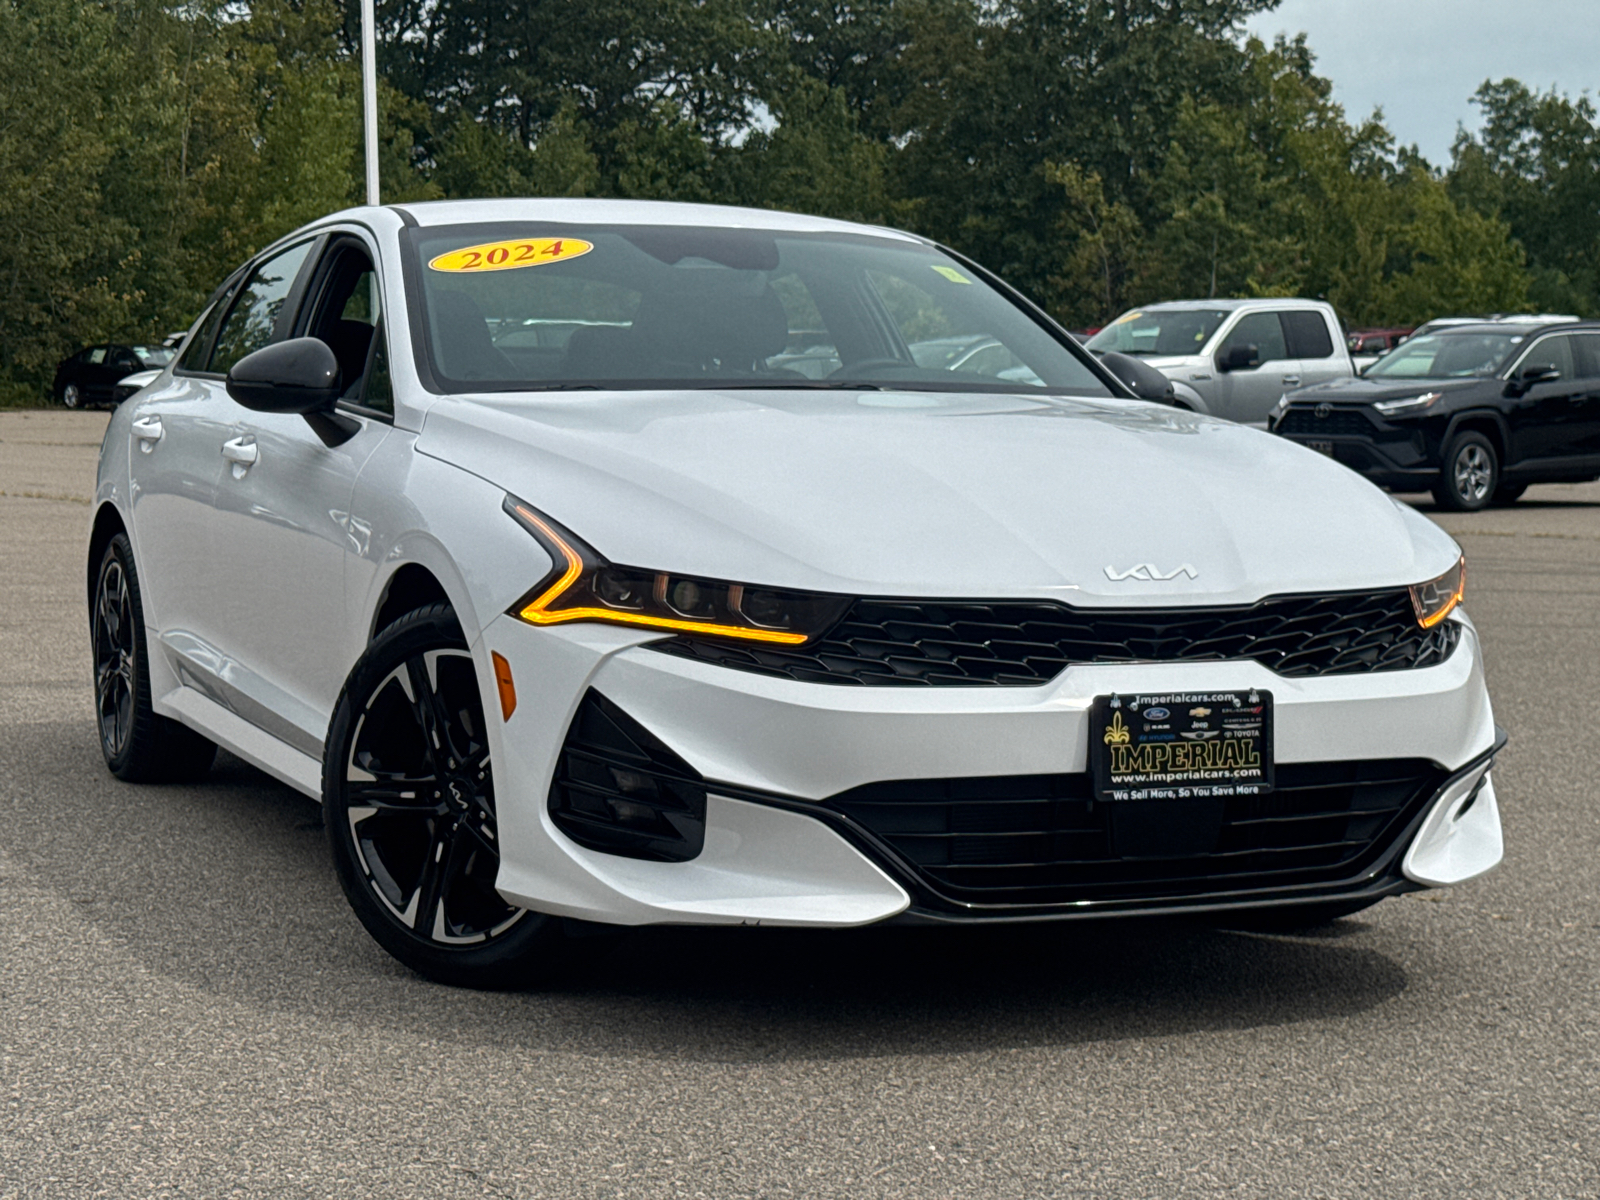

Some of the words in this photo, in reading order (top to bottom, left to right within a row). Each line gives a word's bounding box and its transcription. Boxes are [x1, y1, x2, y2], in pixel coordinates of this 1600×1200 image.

[461, 241, 564, 269] 2024
[1191, 721, 1208, 729] Jeep
[1111, 739, 1261, 773] IMPERIAL
[1111, 768, 1261, 783] www.imperialcars.com
[1114, 791, 1128, 800] We
[1131, 790, 1148, 799] Sell
[1150, 790, 1176, 799] More,
[1178, 788, 1191, 797] So
[1192, 788, 1210, 796] You
[1212, 787, 1233, 795] Save
[1237, 786, 1259, 794] More
